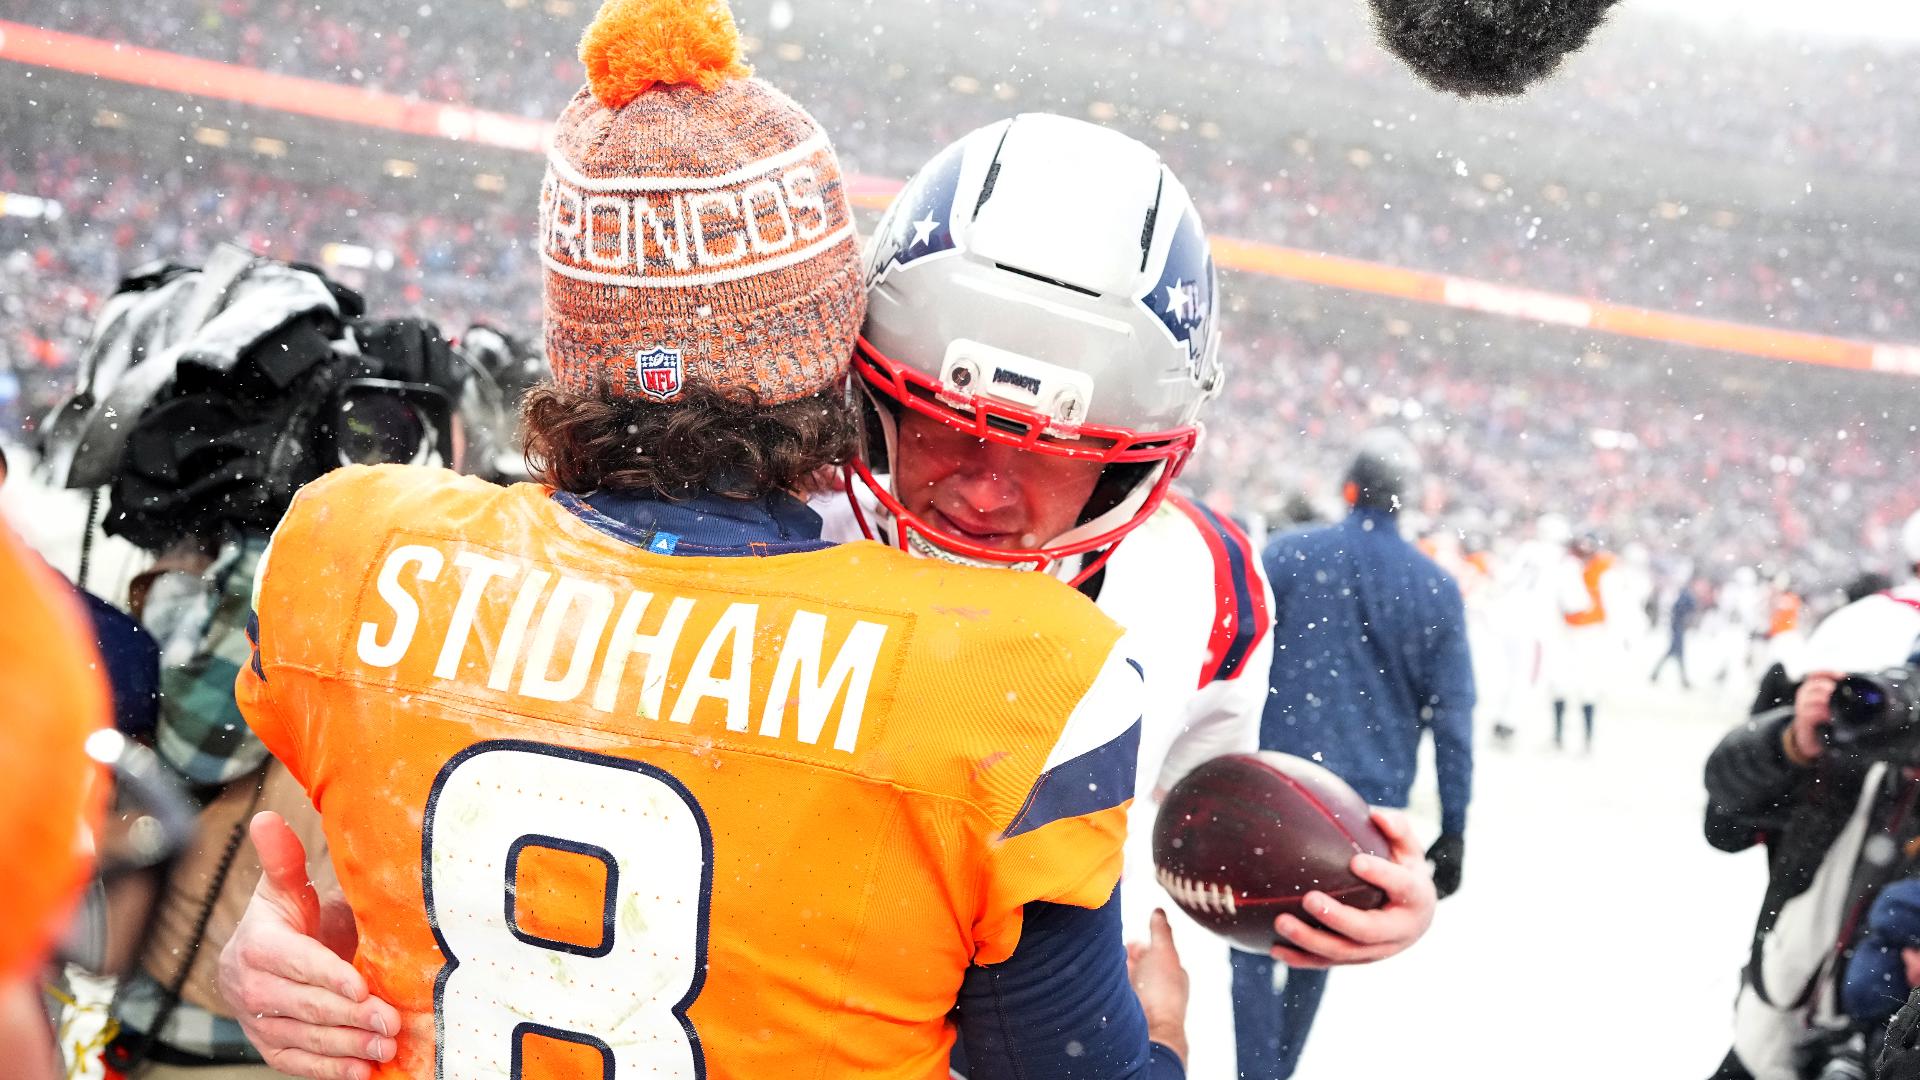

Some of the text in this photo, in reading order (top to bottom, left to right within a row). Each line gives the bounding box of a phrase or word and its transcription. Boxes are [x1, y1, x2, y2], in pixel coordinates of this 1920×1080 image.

[644, 369, 676, 392] NFL
[992, 367, 1041, 396] PATRIOTS
[356, 544, 889, 754] STIDHAM
[421, 739, 715, 1080] 8
